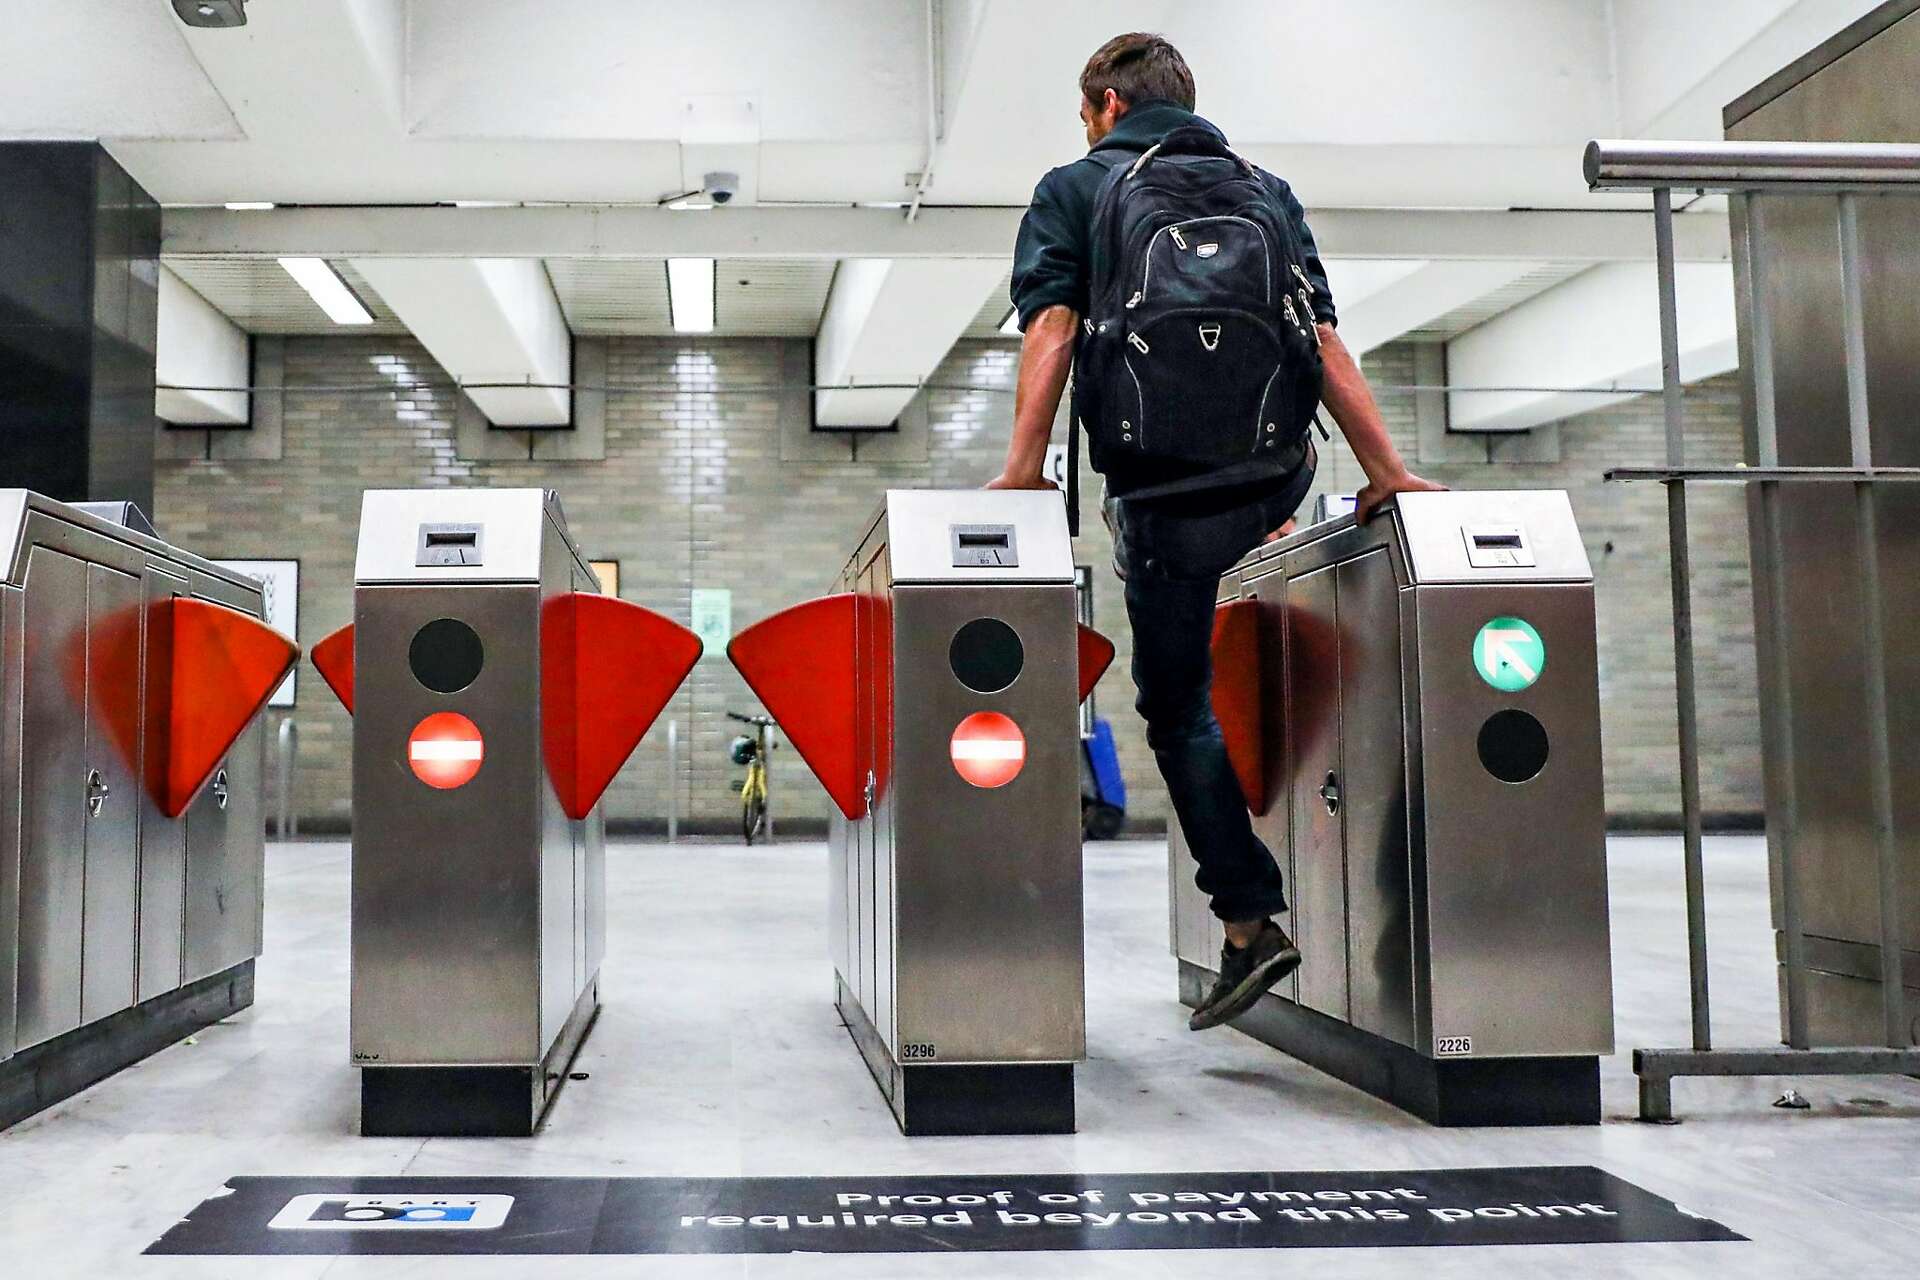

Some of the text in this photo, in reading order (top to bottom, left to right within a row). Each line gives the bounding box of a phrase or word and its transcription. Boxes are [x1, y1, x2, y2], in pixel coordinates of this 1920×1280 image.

[903, 1044, 935, 1057] 3296
[1439, 1038, 1470, 1052] 2226
[835, 1187, 1428, 1207] Proof of payment
[678, 1201, 1619, 1230] required beyond this point
